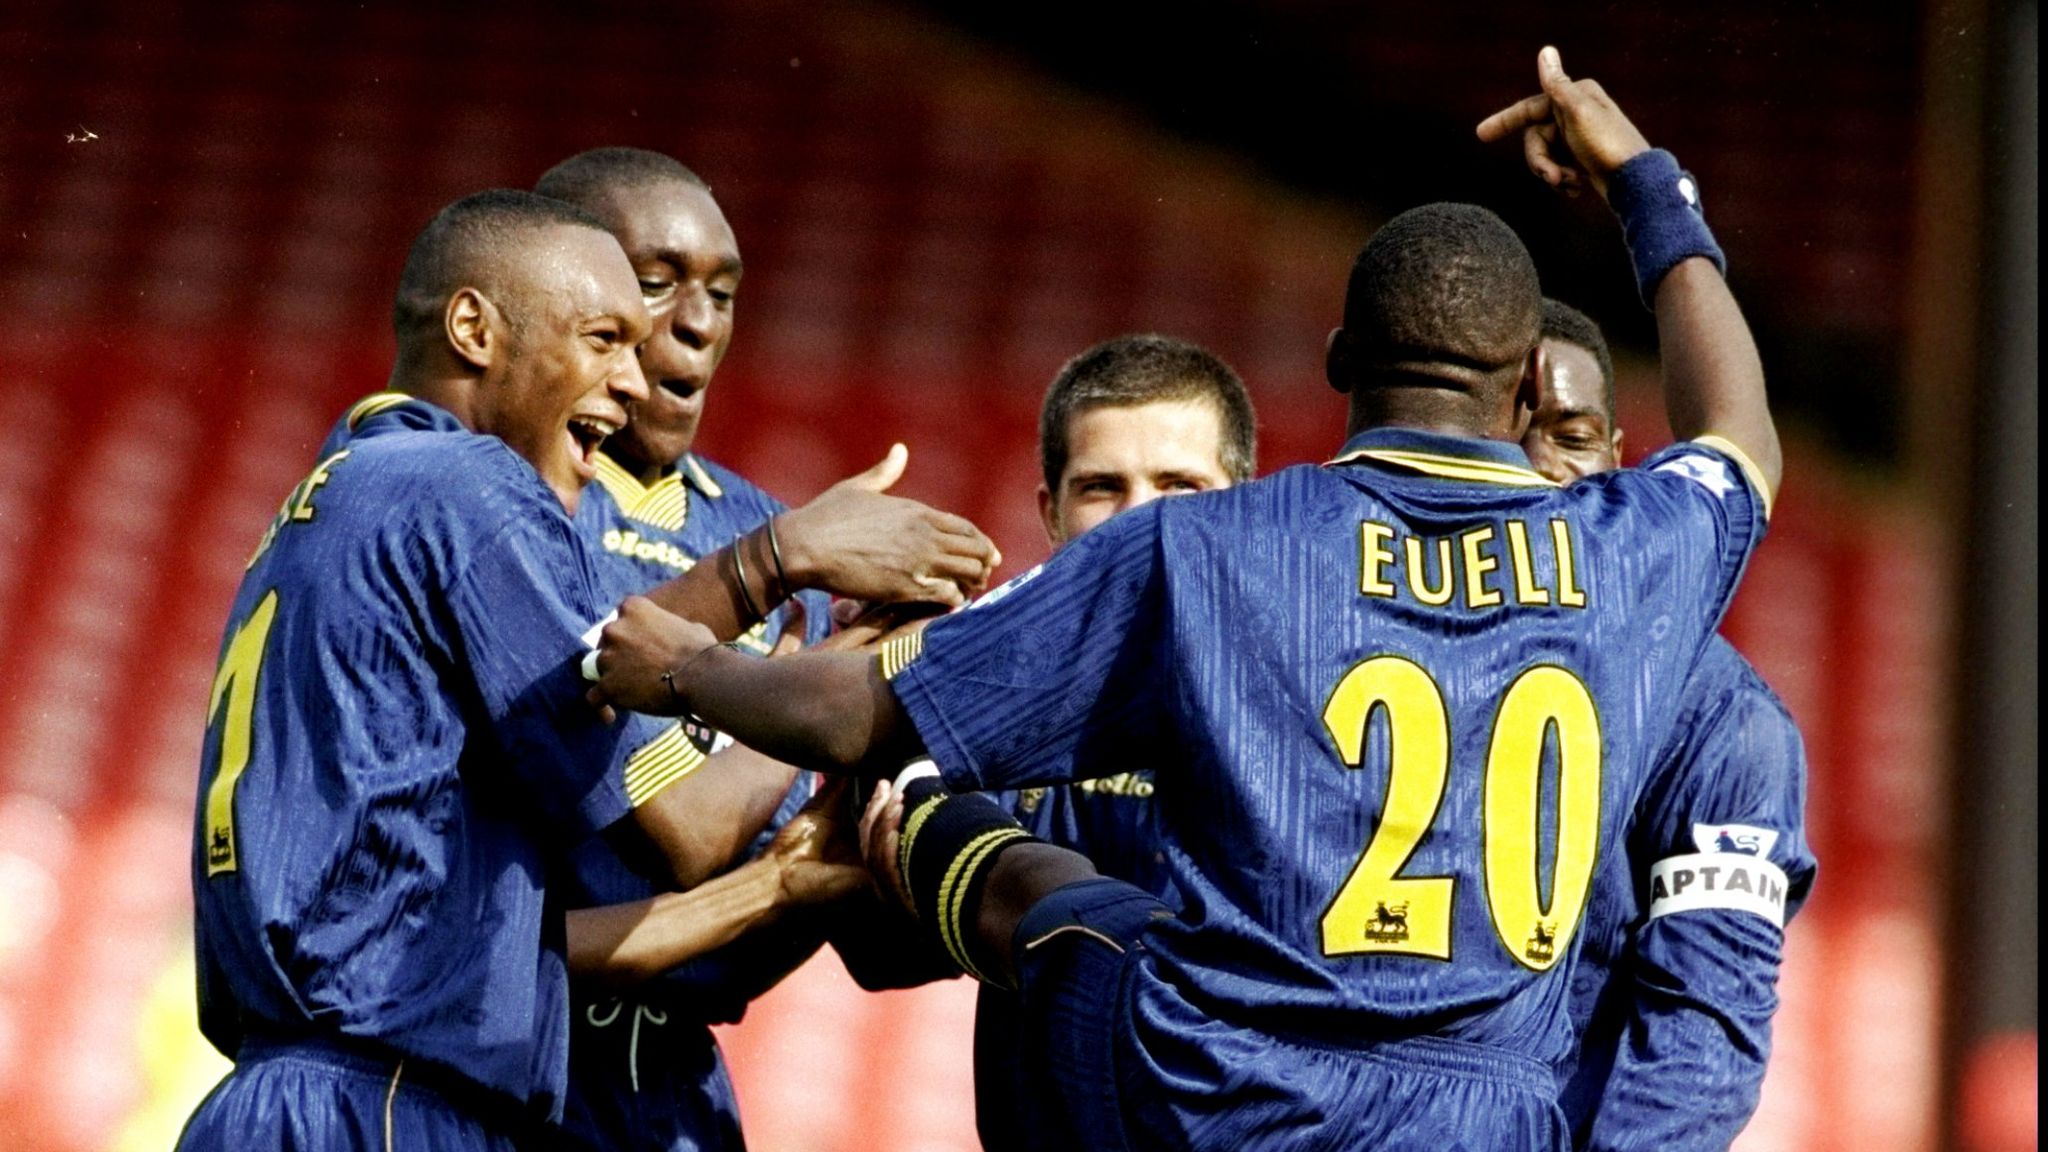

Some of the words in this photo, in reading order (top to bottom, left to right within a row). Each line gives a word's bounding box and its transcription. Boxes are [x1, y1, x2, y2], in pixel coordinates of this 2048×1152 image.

[1359, 518, 1587, 610] EUELL
[1319, 654, 1604, 972] 20
[1651, 866, 1782, 908] APTAIN
